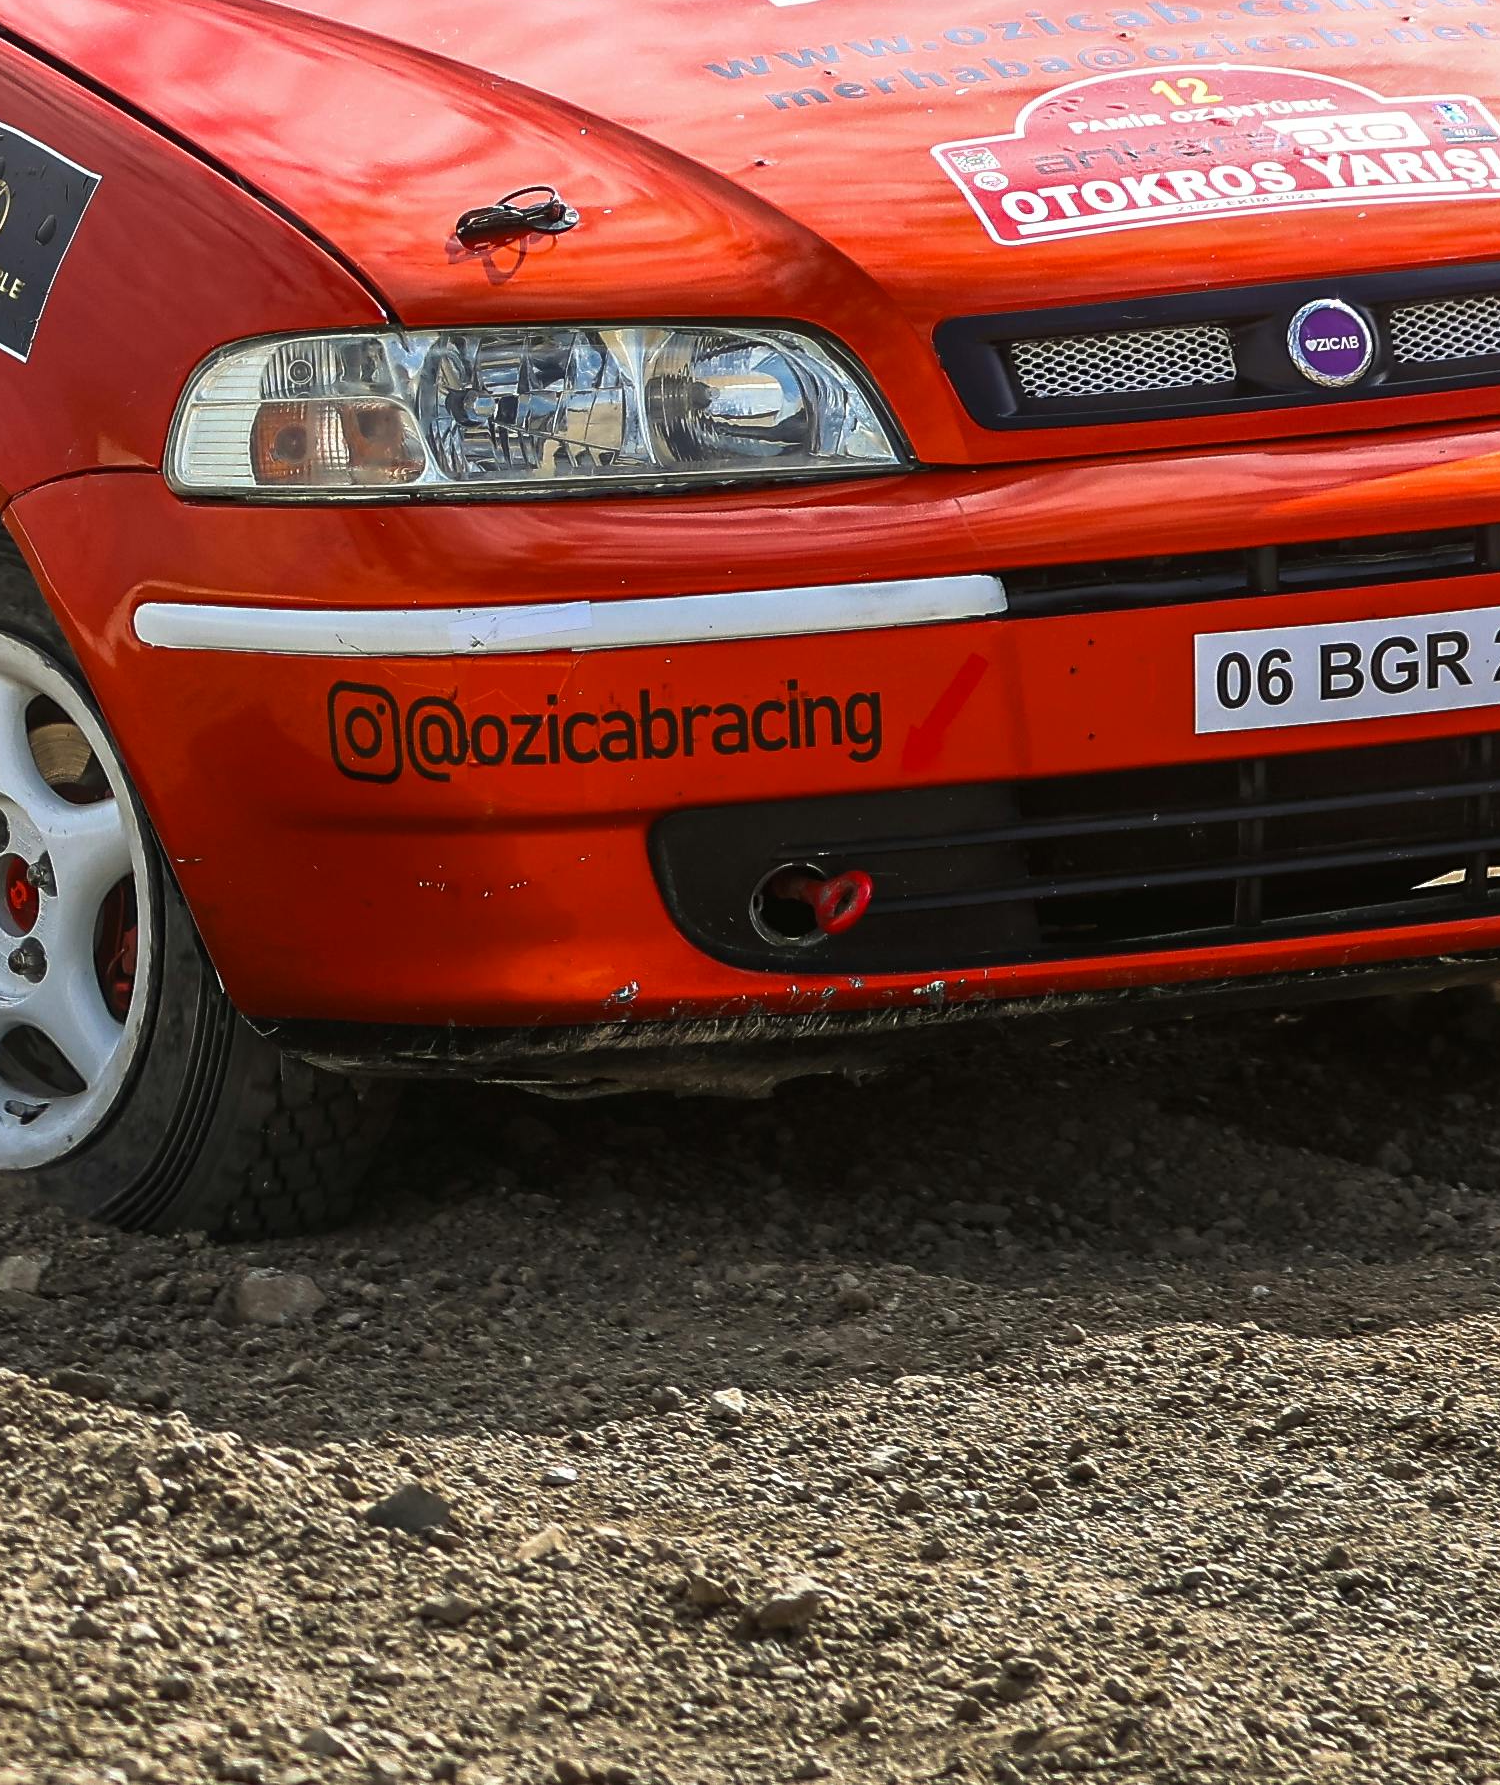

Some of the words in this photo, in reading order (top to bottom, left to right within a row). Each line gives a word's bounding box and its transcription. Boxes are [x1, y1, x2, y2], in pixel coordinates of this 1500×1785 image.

[765, 21, 1498, 110] merhaba@ozicab.net
[1150, 77, 1225, 106] 12
[1068, 113, 1166, 135] PAMİR
[1001, 161, 1298, 224] OTOKROS
[1216, 648, 1294, 710] 06
[1320, 630, 1474, 702] BGR
[405, 679, 882, 784] @ozicabracing
